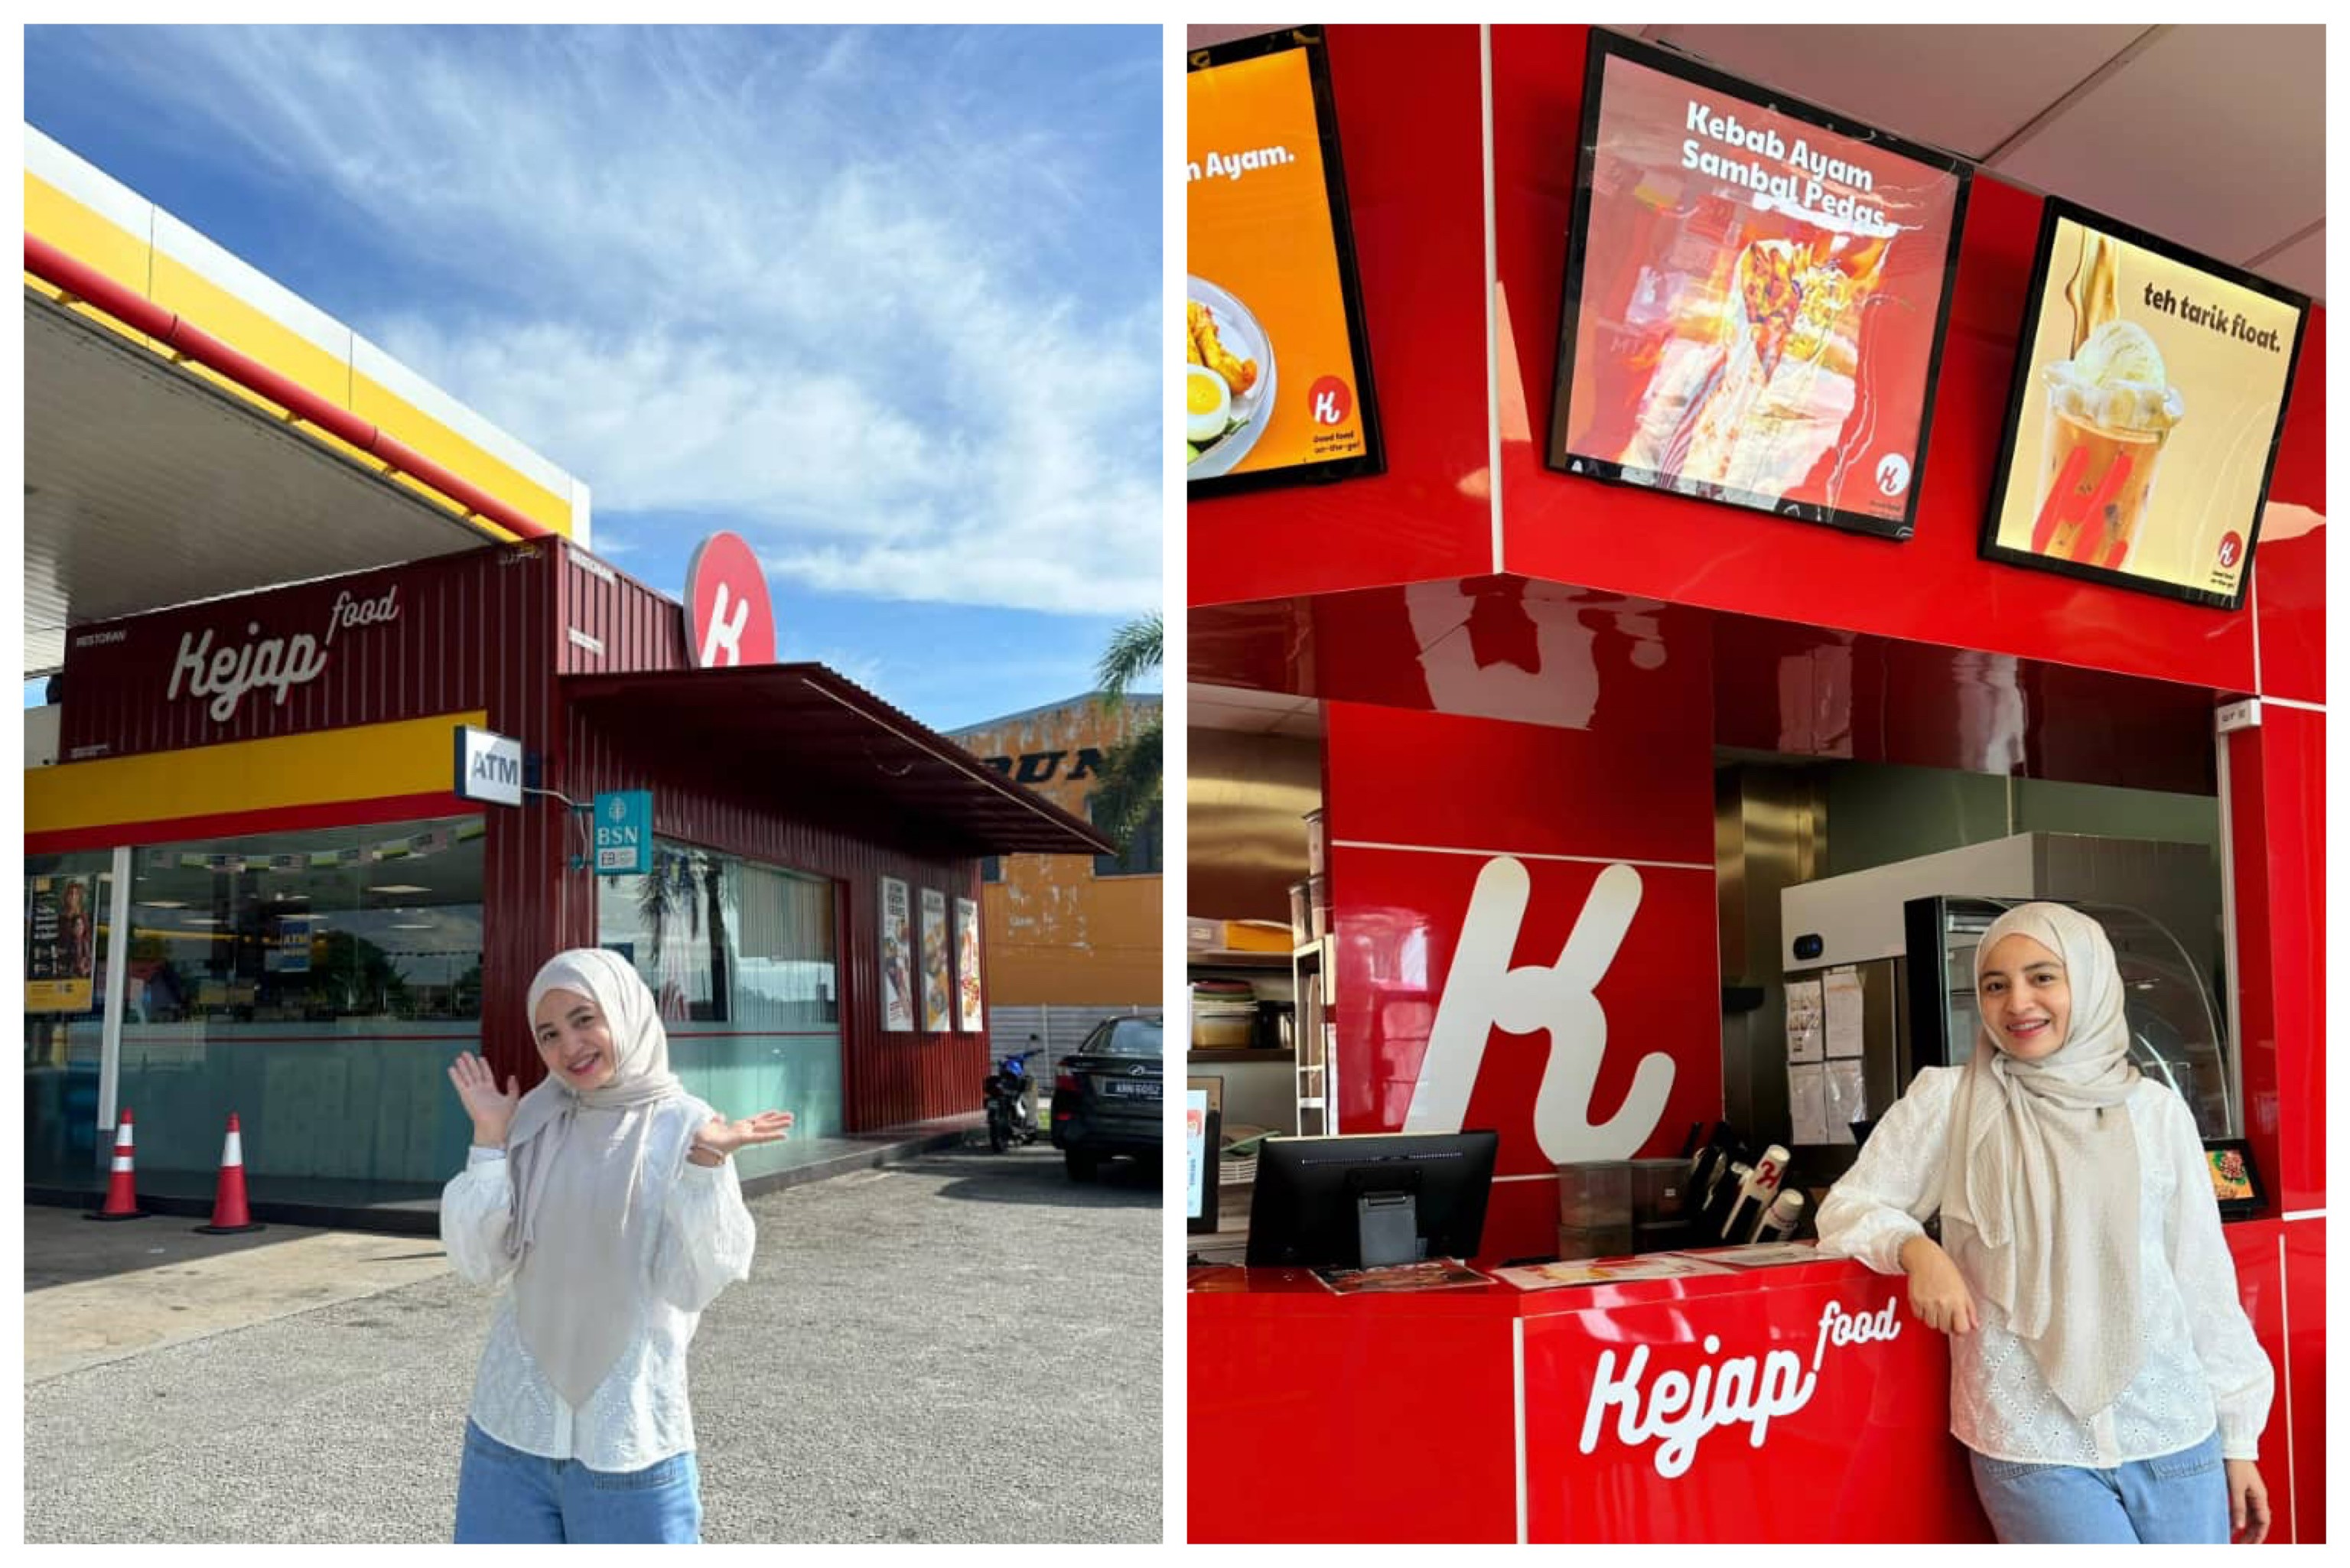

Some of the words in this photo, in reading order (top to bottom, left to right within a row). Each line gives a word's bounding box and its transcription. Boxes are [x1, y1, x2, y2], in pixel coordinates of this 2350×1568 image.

[1206, 145, 1294, 180] Ayam.
[1682, 138, 1798, 203] Sambal
[1686, 101, 1785, 160] Kebab
[1789, 138, 1873, 191] Ayam
[2143, 281, 2176, 315] teh
[2180, 295, 2229, 334] tarik
[2231, 313, 2280, 353] float.
[1314, 390, 1341, 424] K
[1879, 464, 1899, 493] K
[2219, 541, 2235, 566] K
[324, 583, 400, 646] food
[701, 581, 749, 667] K
[167, 620, 328, 722] Kejap
[472, 750, 518, 786] ATM
[597, 825, 639, 846] BSN
[1401, 855, 1677, 1165] K
[1814, 1296, 1902, 1373] food
[1578, 1334, 1818, 1479] Kejap
